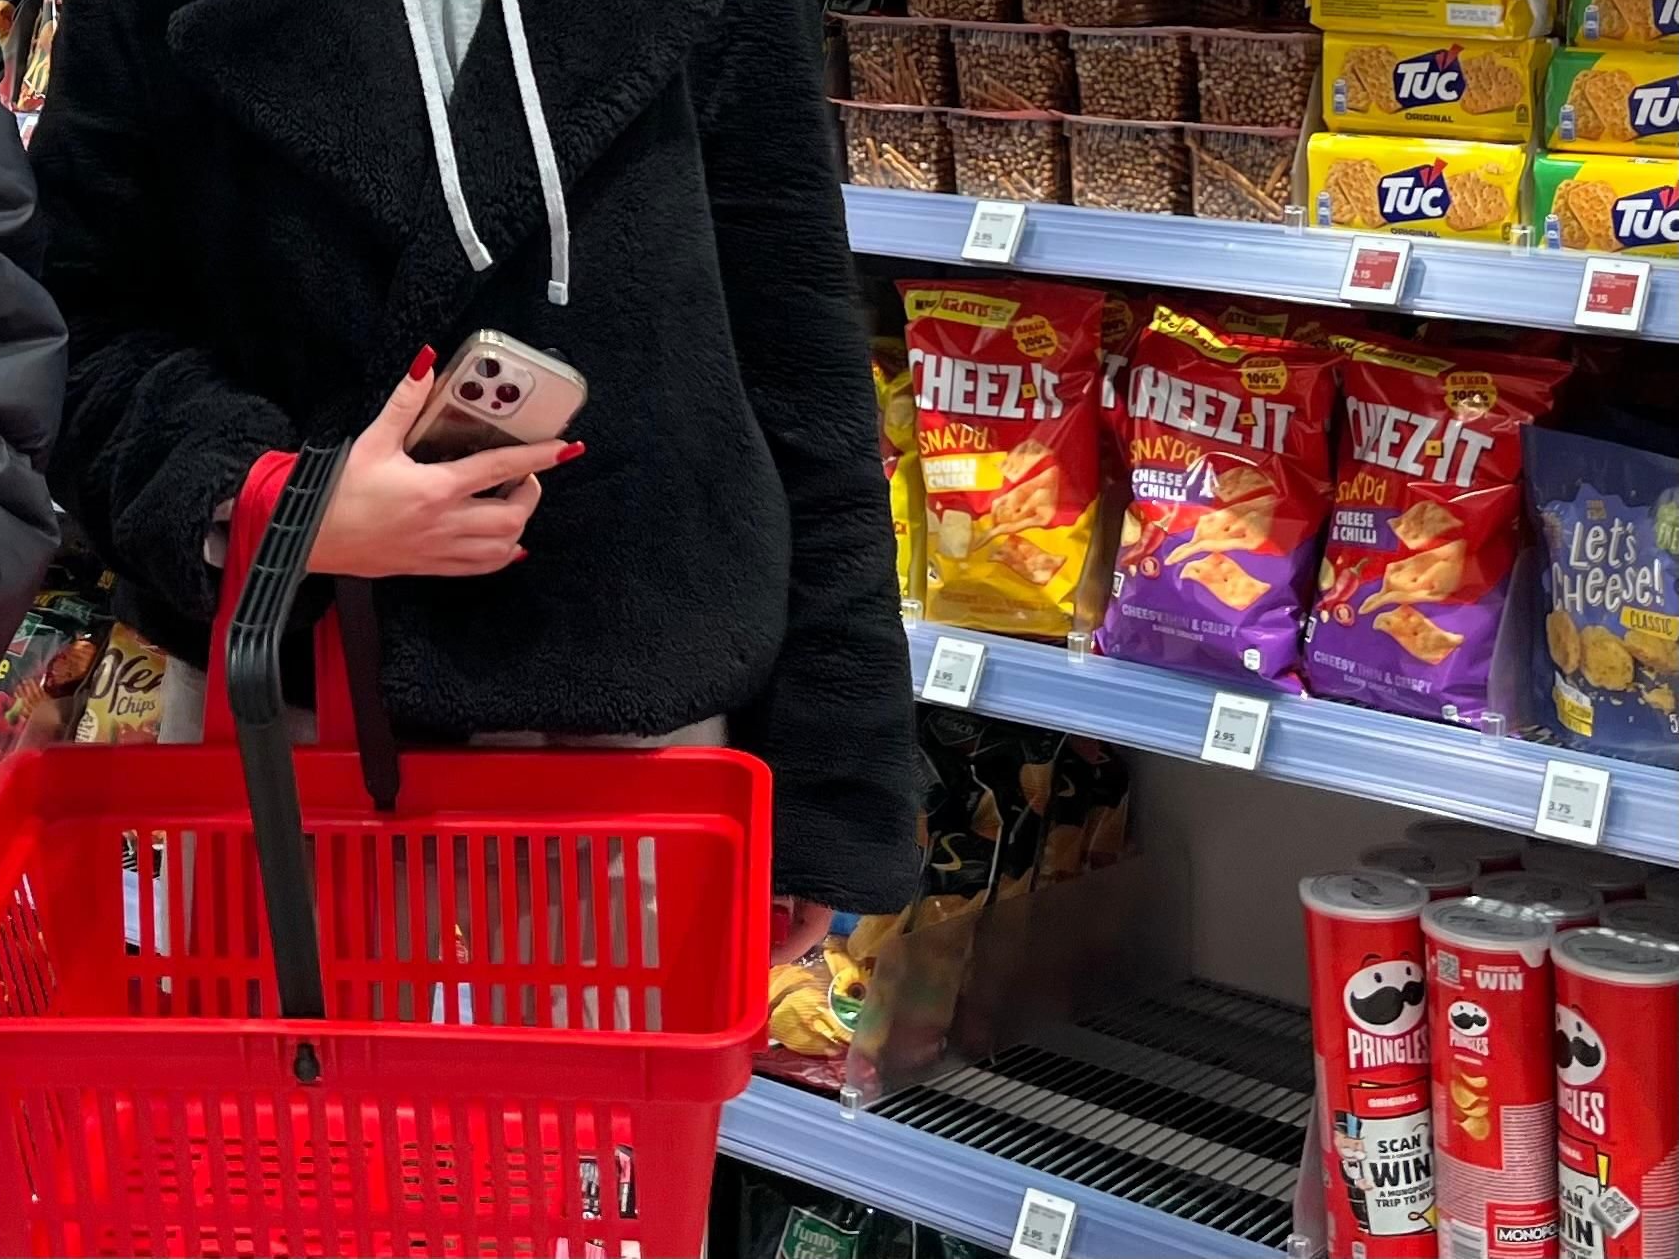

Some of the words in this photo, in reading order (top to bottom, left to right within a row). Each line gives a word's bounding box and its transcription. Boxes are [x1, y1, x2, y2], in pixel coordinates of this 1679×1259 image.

[1398, 62, 1460, 102] TUC
[1633, 86, 1679, 128] TU
[1404, 112, 1454, 124] ORIGINAL
[1381, 176, 1444, 217] TUC
[1390, 227, 1441, 239] ORIGINAL
[1246, 371, 1280, 385] 100%
[1132, 468, 1183, 486] CHEESE
[1336, 510, 1374, 528] CHEESE
[1332, 525, 1339, 541] &
[1340, 526, 1377, 544] CHILLI
[1569, 518, 1637, 570] Let's
[1121, 603, 1163, 623] CHEESY
[1191, 618, 1200, 631] &
[1201, 620, 1238, 638] CRISPY
[1629, 609, 1673, 636] CLASSIC
[1313, 650, 1356, 674] CHEESY
[1384, 671, 1393, 686] &
[1394, 674, 1433, 695] CRISPY
[116, 696, 156, 718] Chips
[1213, 729, 1235, 742] 2.95
[1548, 800, 1571, 815] 3.75
[1475, 971, 1525, 992] WIN
[1377, 1133, 1422, 1154] SCAN
[1369, 1153, 1432, 1188] WIN
[1375, 1198, 1402, 1208] TRIP
[1403, 1195, 1417, 1206] TO
[1022, 1225, 1043, 1242] 2.95
